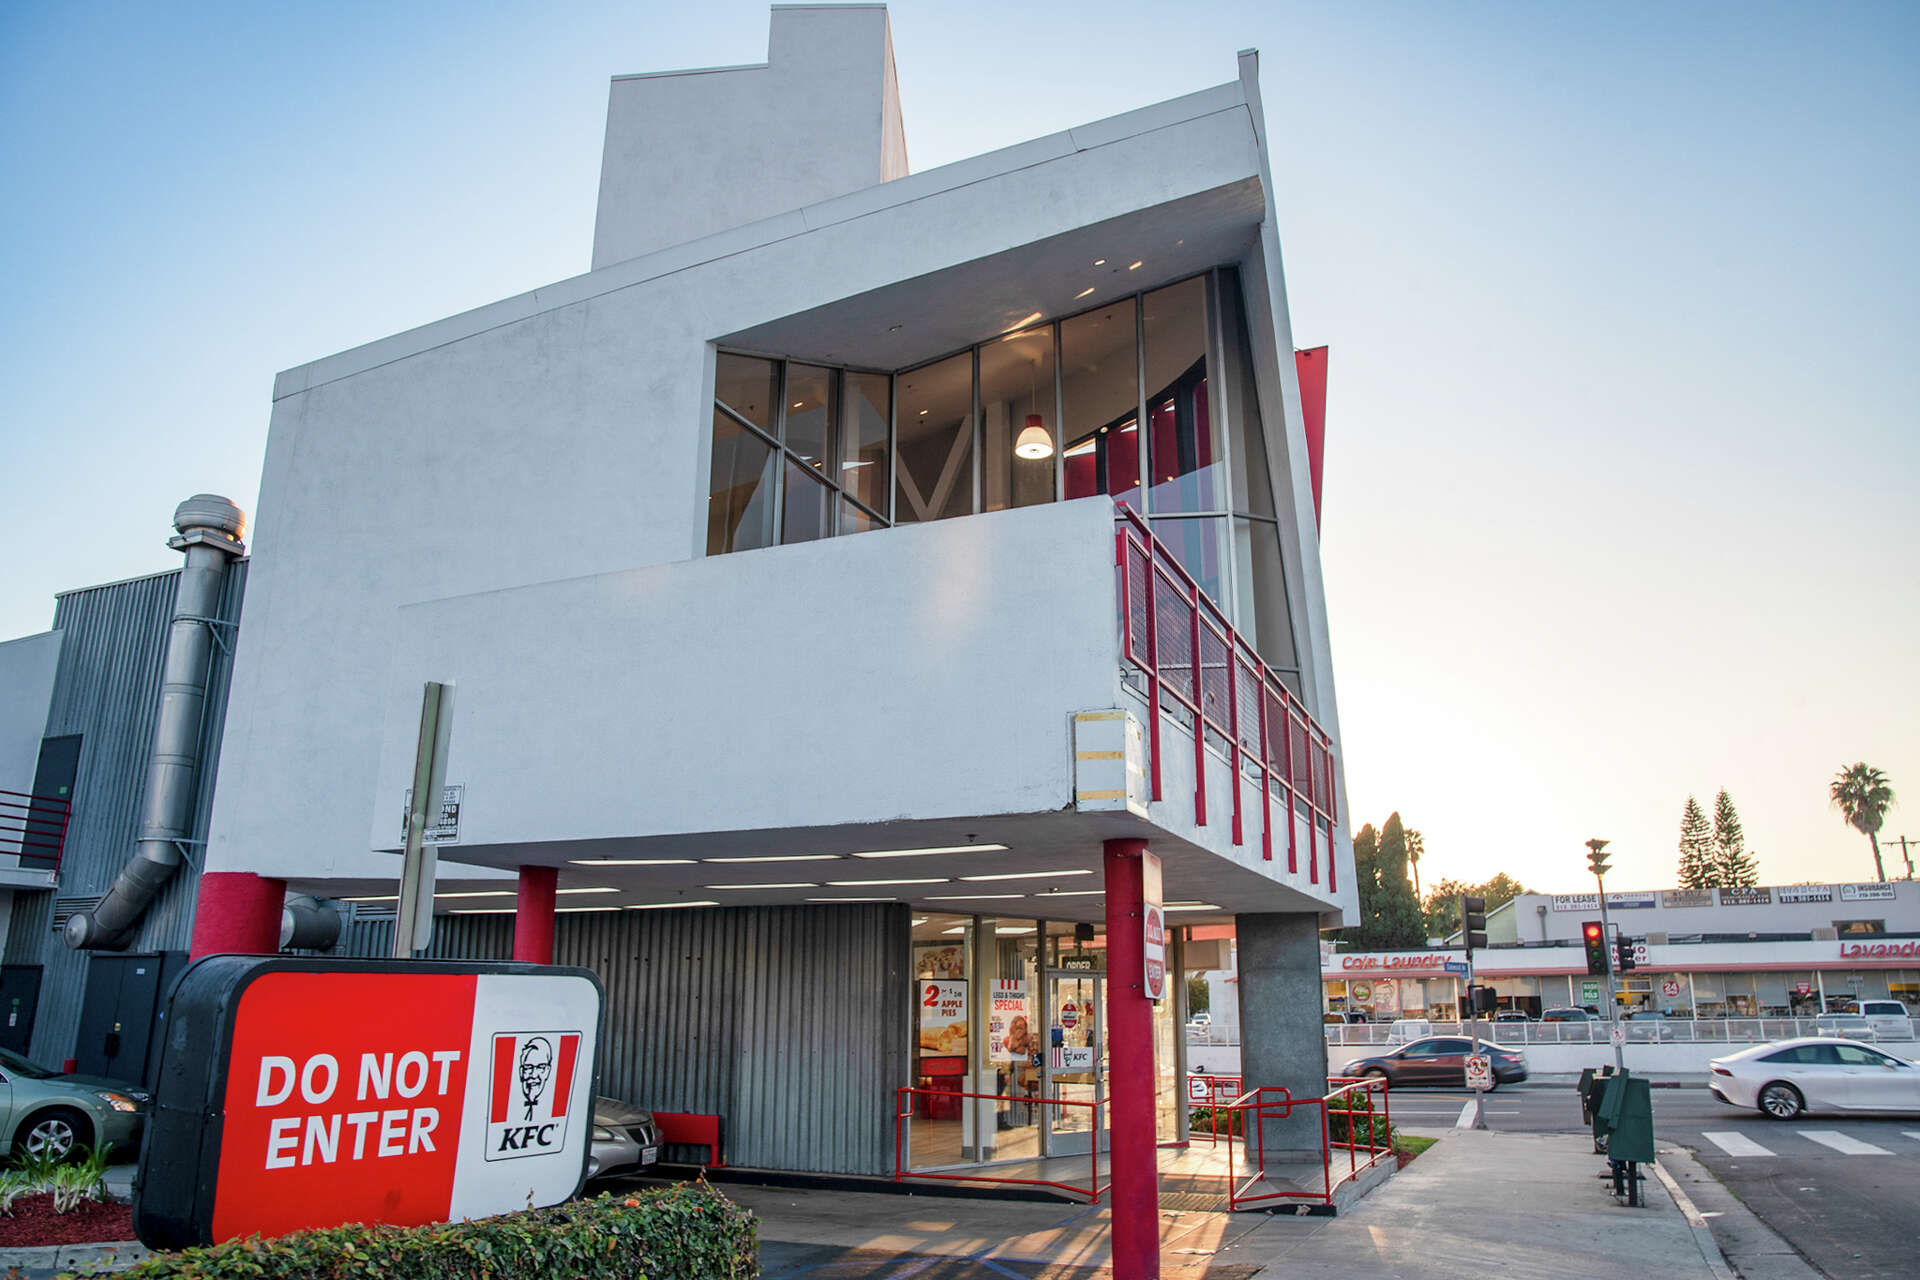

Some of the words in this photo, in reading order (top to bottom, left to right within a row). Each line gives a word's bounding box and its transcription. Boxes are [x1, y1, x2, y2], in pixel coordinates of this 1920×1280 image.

[1731, 887, 1758, 895] CPA
[1555, 896, 1571, 904] FOR
[1573, 895, 1597, 903] LEASE
[1342, 956, 1377, 971] Coin
[1383, 953, 1452, 969] Laundry
[1664, 983, 1678, 994] 24
[923, 984, 940, 1007] 2
[941, 1000, 963, 1008] APPLE
[994, 999, 1024, 1011] SPECIAL
[941, 1008, 957, 1017] PIES
[1073, 1053, 1088, 1061] KFC
[256, 1053, 339, 1107] DO
[357, 1050, 461, 1101] NOT
[265, 1107, 440, 1170] ENTER
[498, 1123, 555, 1151] KFC
